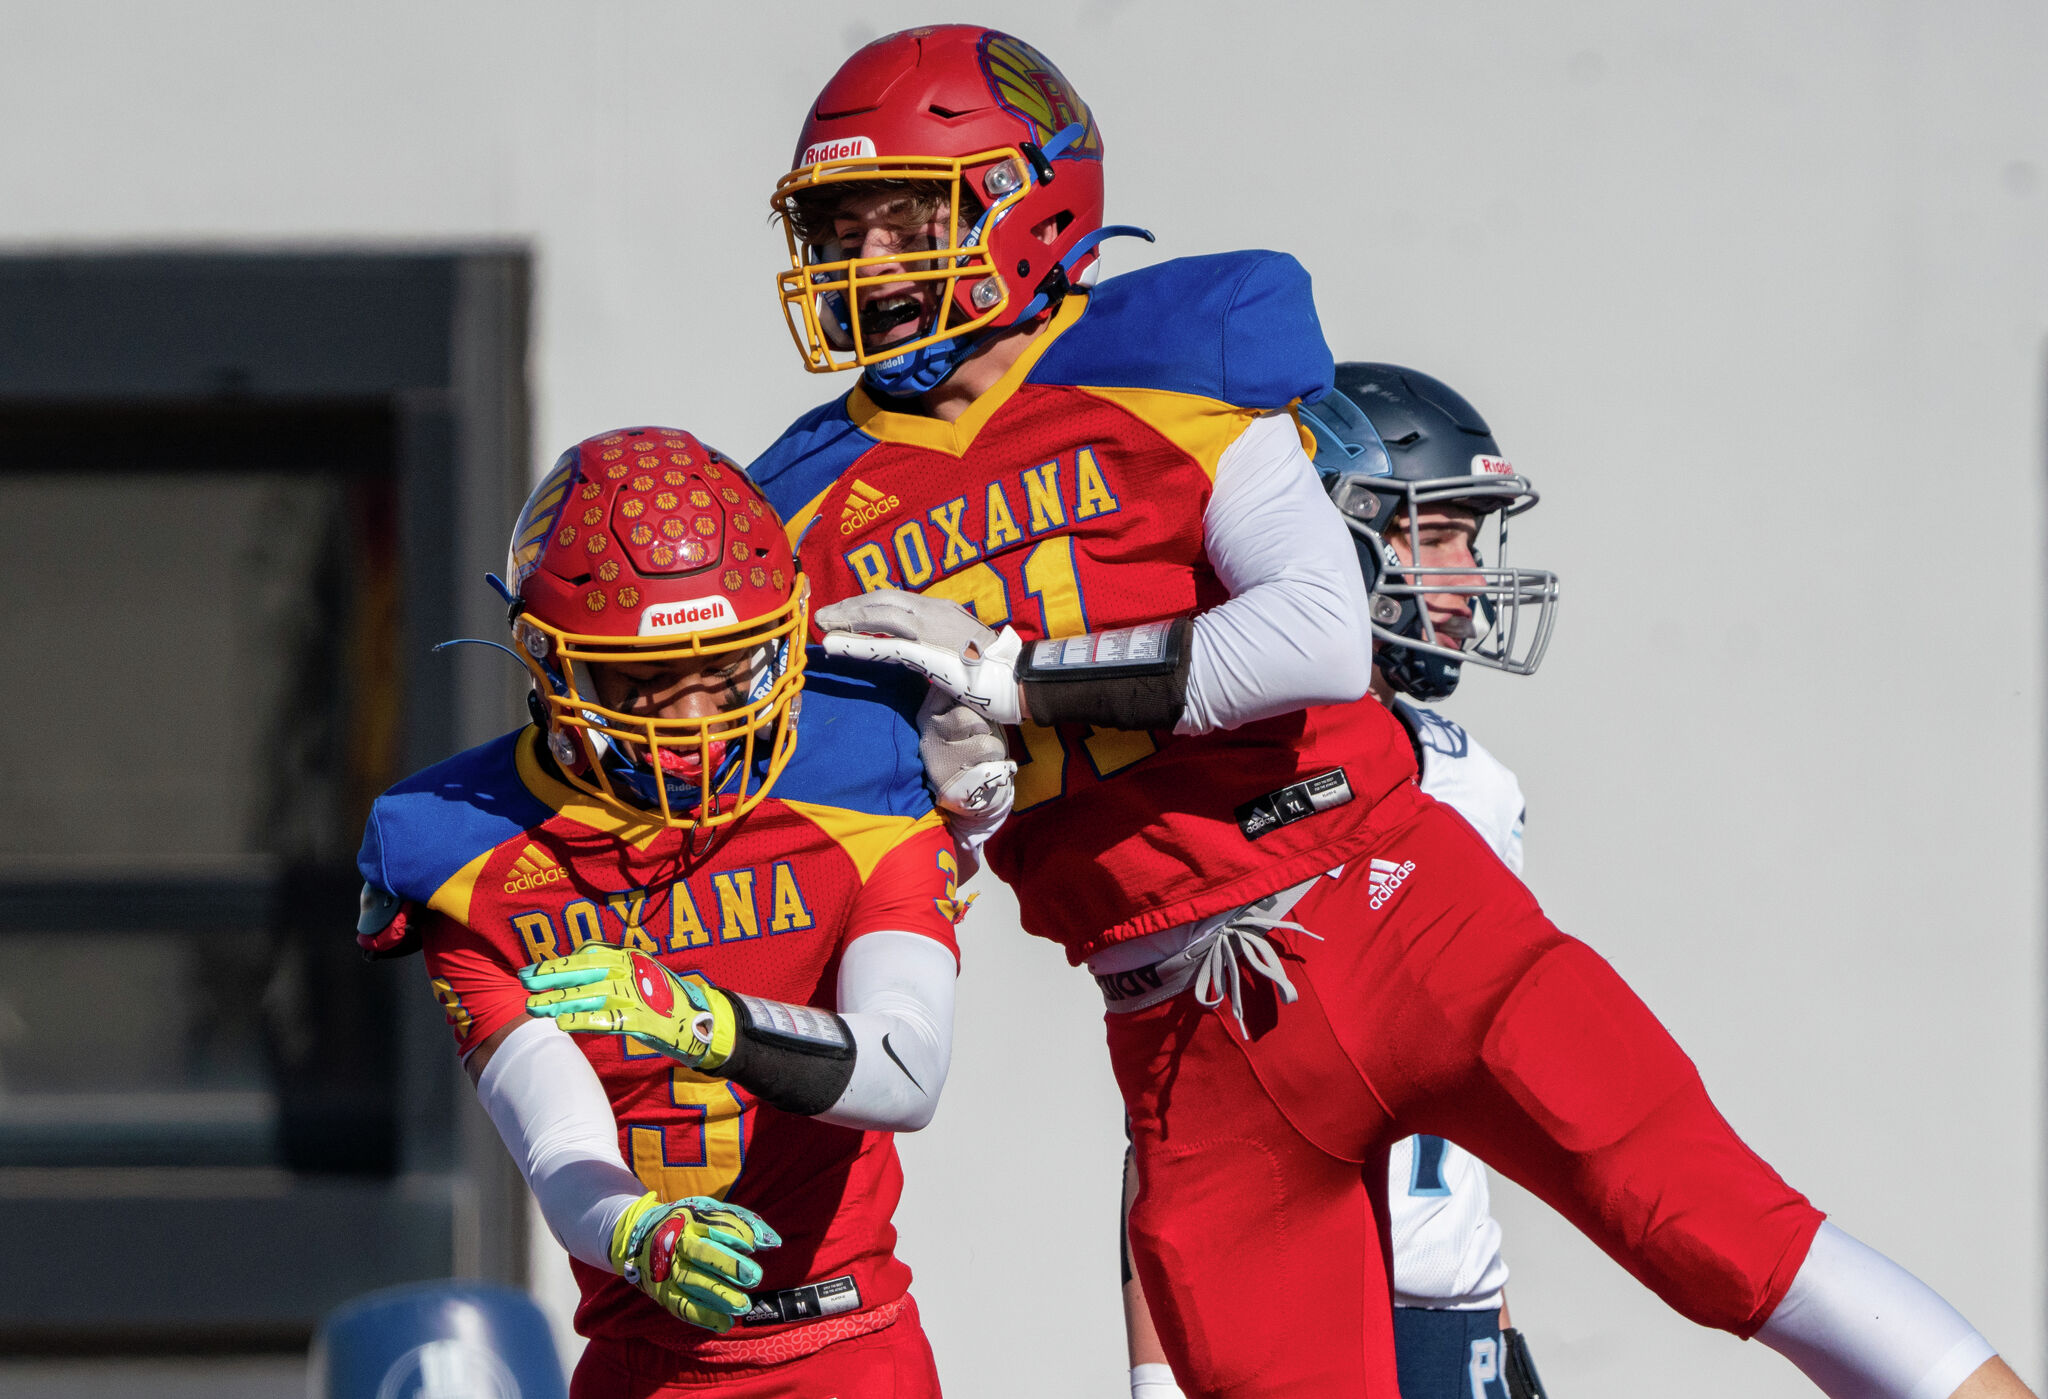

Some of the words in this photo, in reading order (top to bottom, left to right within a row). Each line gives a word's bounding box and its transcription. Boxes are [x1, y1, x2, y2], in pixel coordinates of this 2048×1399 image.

[805, 140, 863, 165] Riddell
[840, 493, 900, 536] adidas
[843, 445, 1121, 594] ROXANA
[650, 602, 725, 628] Riddell
[1286, 799, 1305, 815] XL
[1246, 814, 1277, 834] adidas
[503, 863, 570, 895] adidas
[1369, 859, 1417, 911] adidas
[508, 860, 816, 965] ROXANA
[745, 1311, 780, 1322] adidas
[796, 1300, 808, 1315] M
